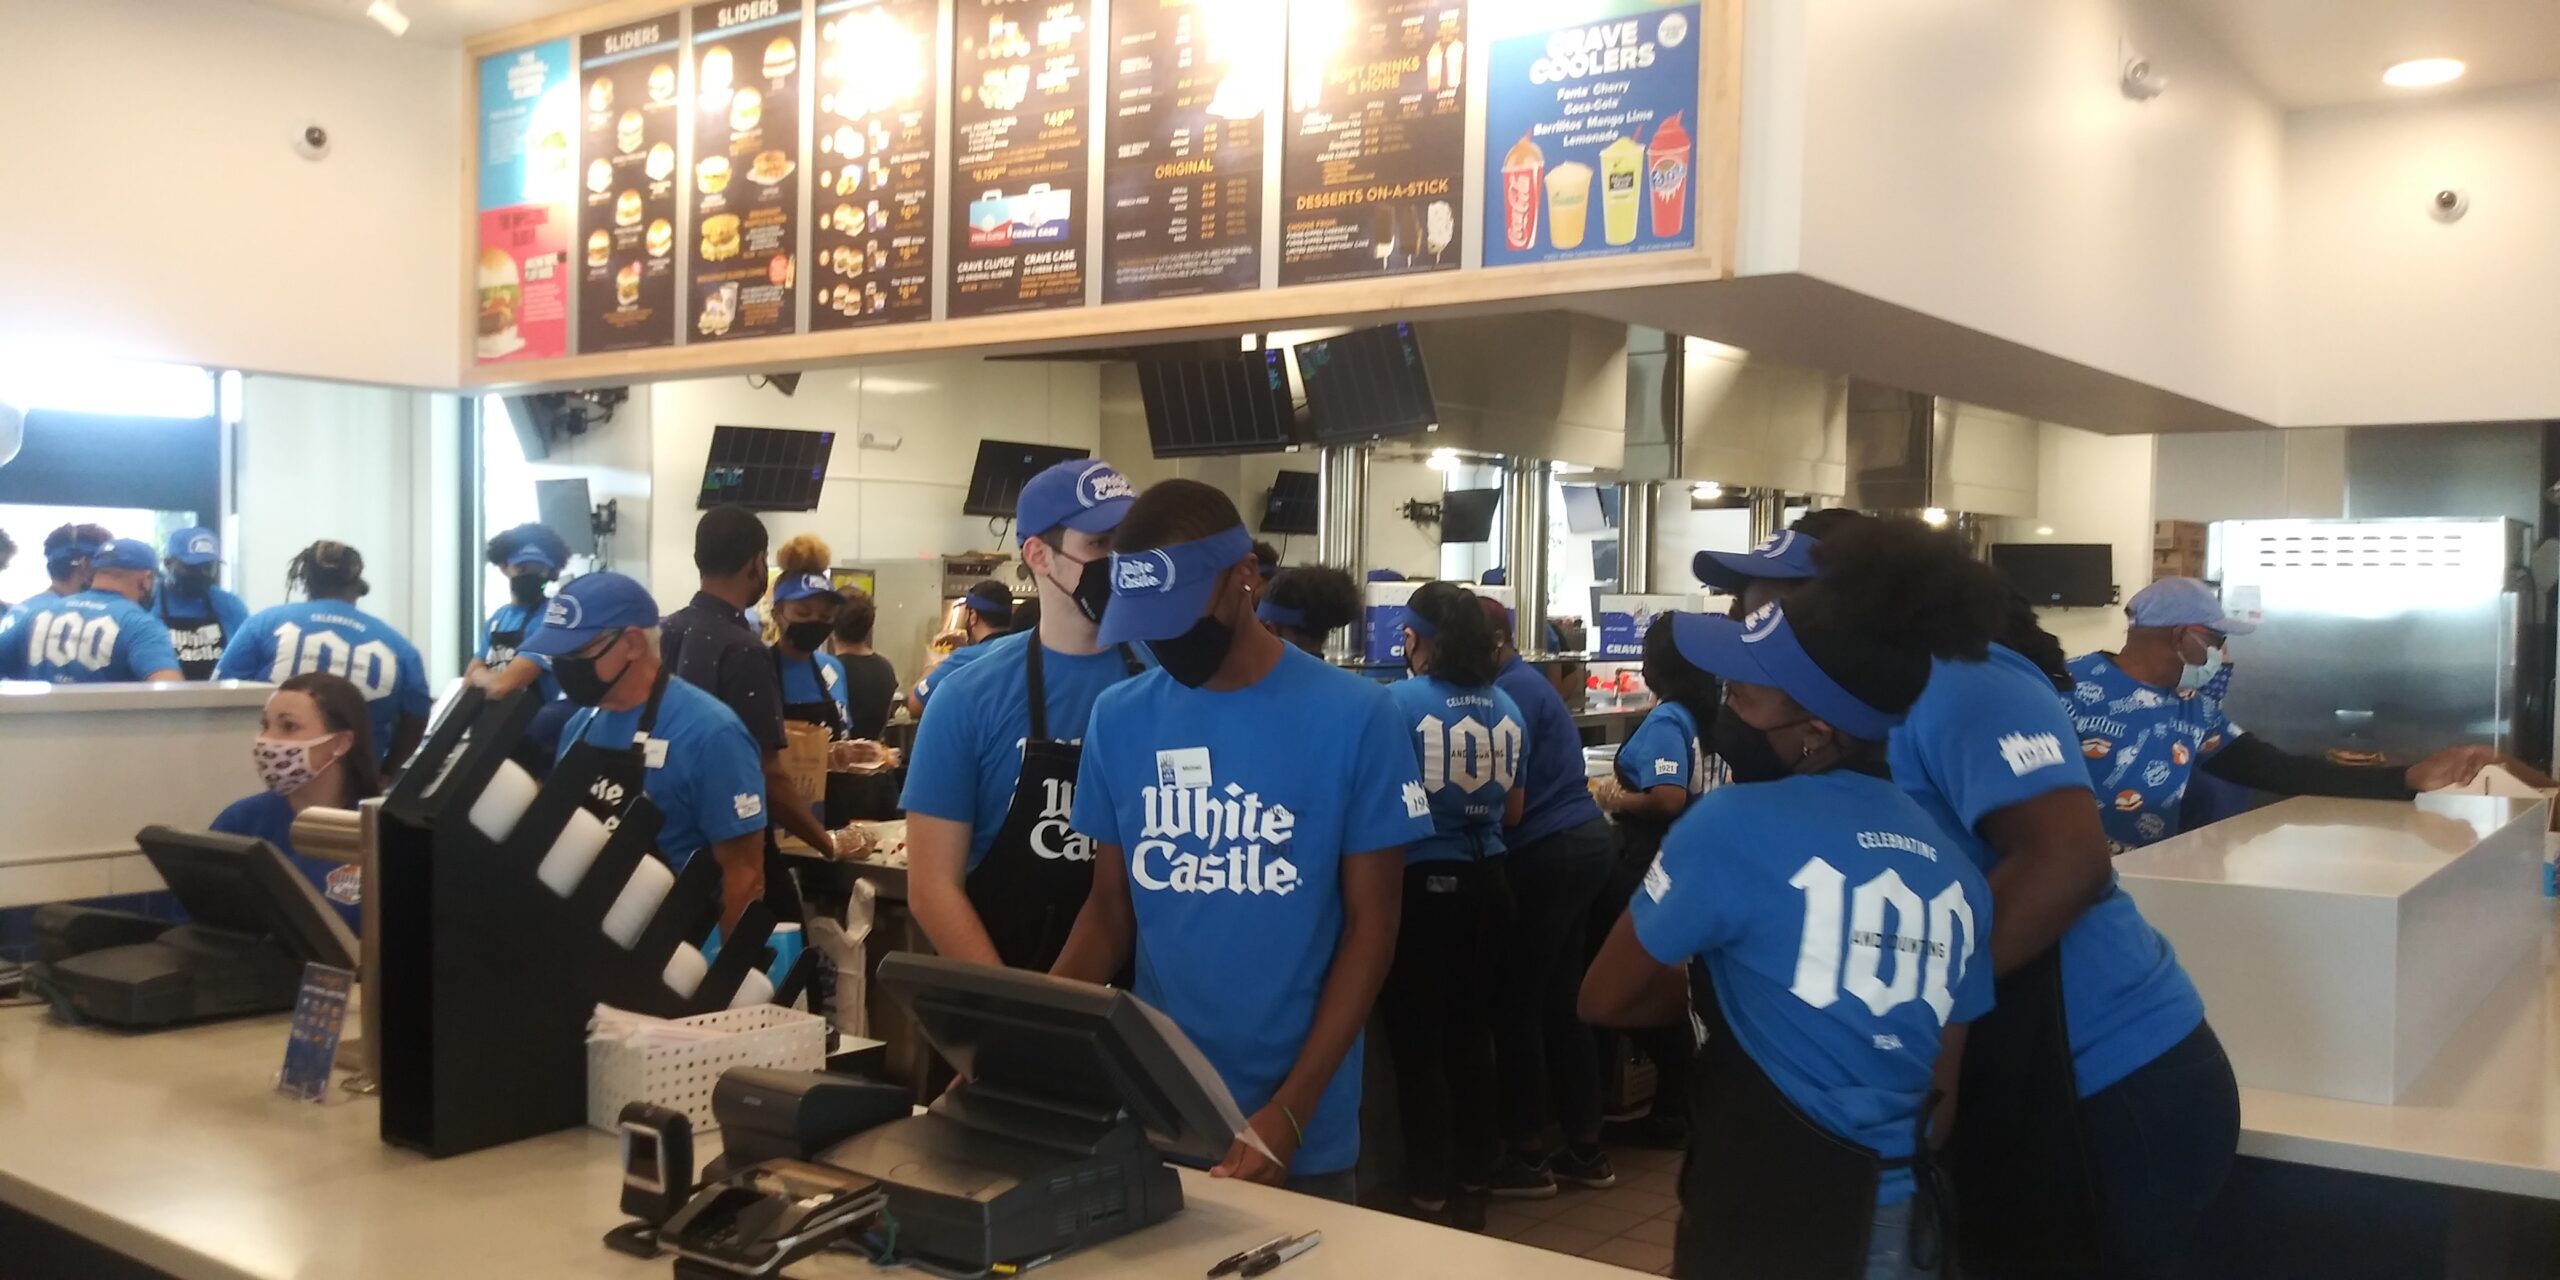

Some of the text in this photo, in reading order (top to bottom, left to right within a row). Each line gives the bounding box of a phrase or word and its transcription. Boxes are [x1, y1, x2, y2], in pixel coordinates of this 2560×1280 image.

[718, 0, 778, 28] SLIDERS
[605, 25, 659, 54] SLIDERS
[1547, 20, 1638, 58] CRAVE
[1368, 55, 1421, 77] DRINKS
[1529, 42, 1655, 84] COOLERS
[1359, 75, 1401, 95] MORE
[1592, 80, 1631, 95] Cherry
[1563, 97, 1619, 116] Coca-Cola
[1587, 113, 1625, 129] Mango
[1626, 108, 1653, 123] Lime
[1563, 129, 1618, 147] Lemonade
[1154, 158, 1214, 180] ORIGINAL
[1296, 178, 1449, 211] DESSERTS ON-A-STICK
[957, 256, 1016, 274] CRAVE CLUTCH
[1024, 248, 1076, 266] CRAVE CASE
[28, 610, 120, 671] 100
[268, 621, 397, 703] 100
[1446, 695, 1494, 708] CELEBRATING
[1415, 713, 1522, 794] 100
[1659, 764, 1674, 772] 1921
[1140, 782, 1295, 850] White
[1857, 831, 1937, 862] CELEBRATING
[1132, 839, 1298, 896] Castle
[1788, 855, 1975, 1028] 100
